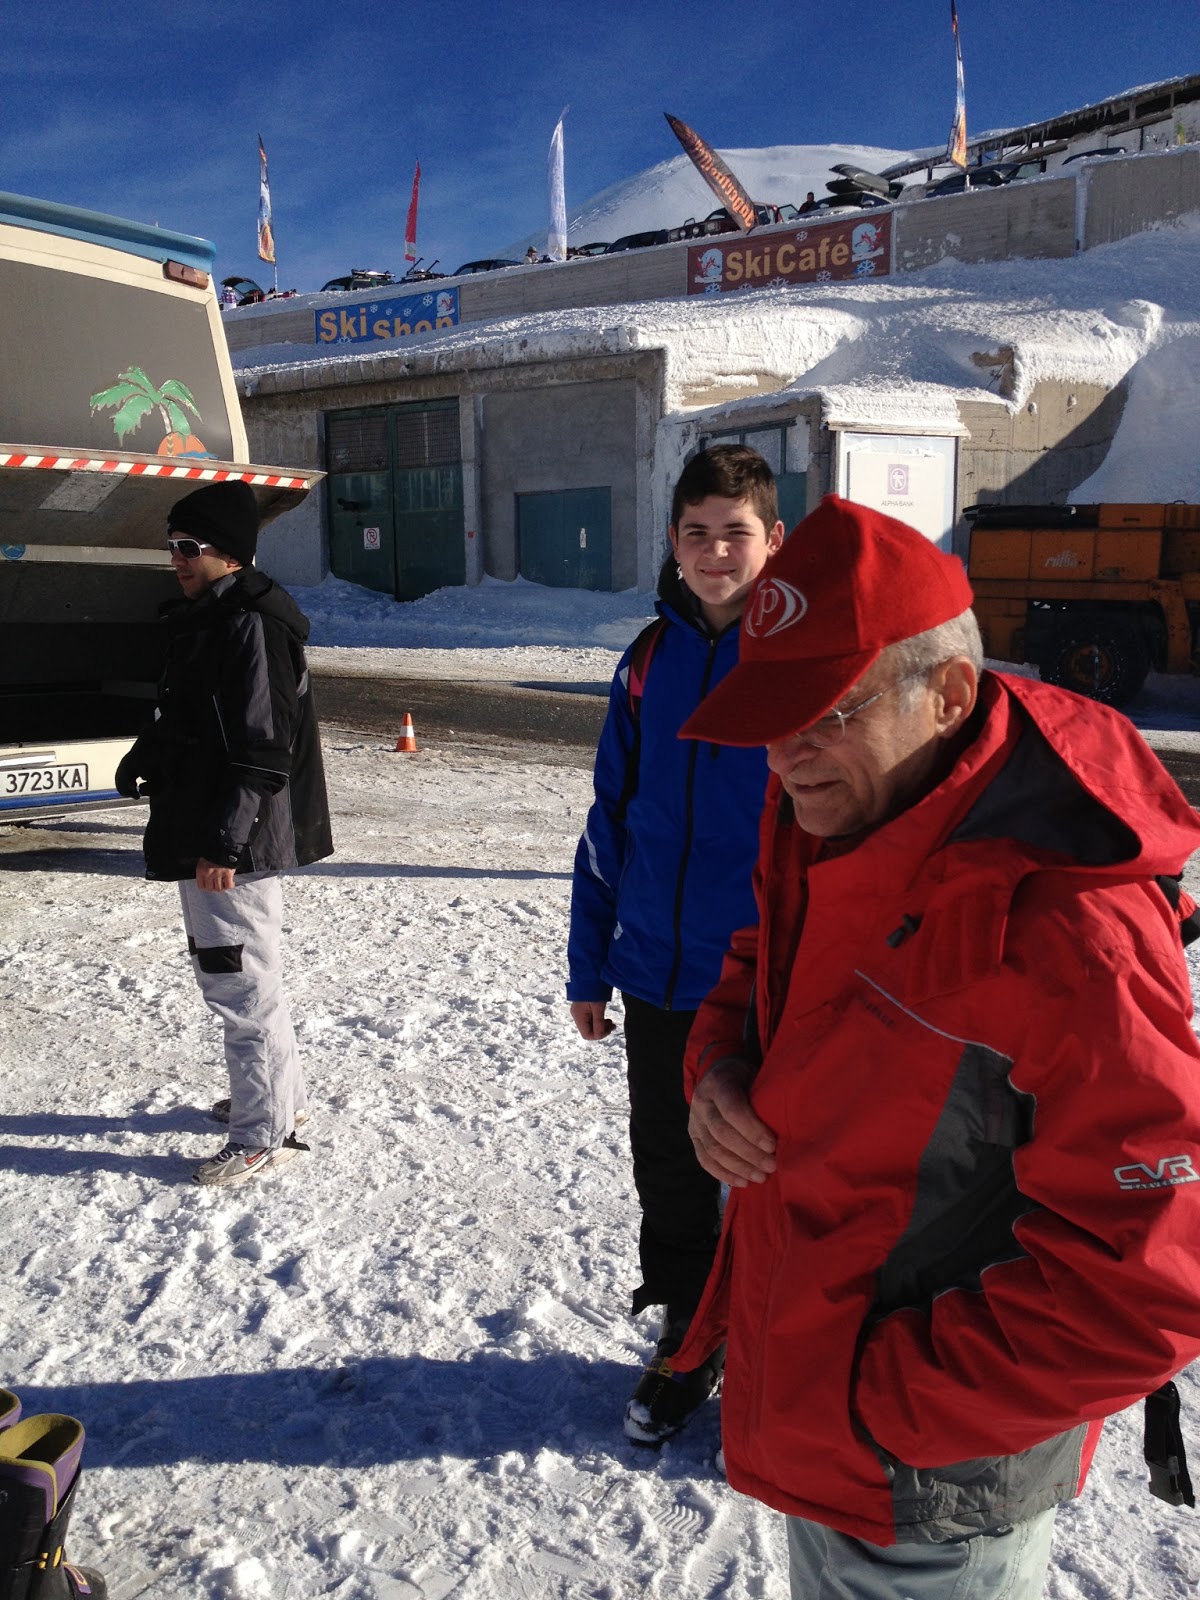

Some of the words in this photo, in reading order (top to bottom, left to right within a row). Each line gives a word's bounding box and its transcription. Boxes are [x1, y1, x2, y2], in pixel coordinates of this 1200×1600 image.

[725, 247, 771, 282] Ski
[776, 235, 849, 275] Café
[319, 307, 367, 342] Ski
[1113, 1154, 1200, 1184] CVR
